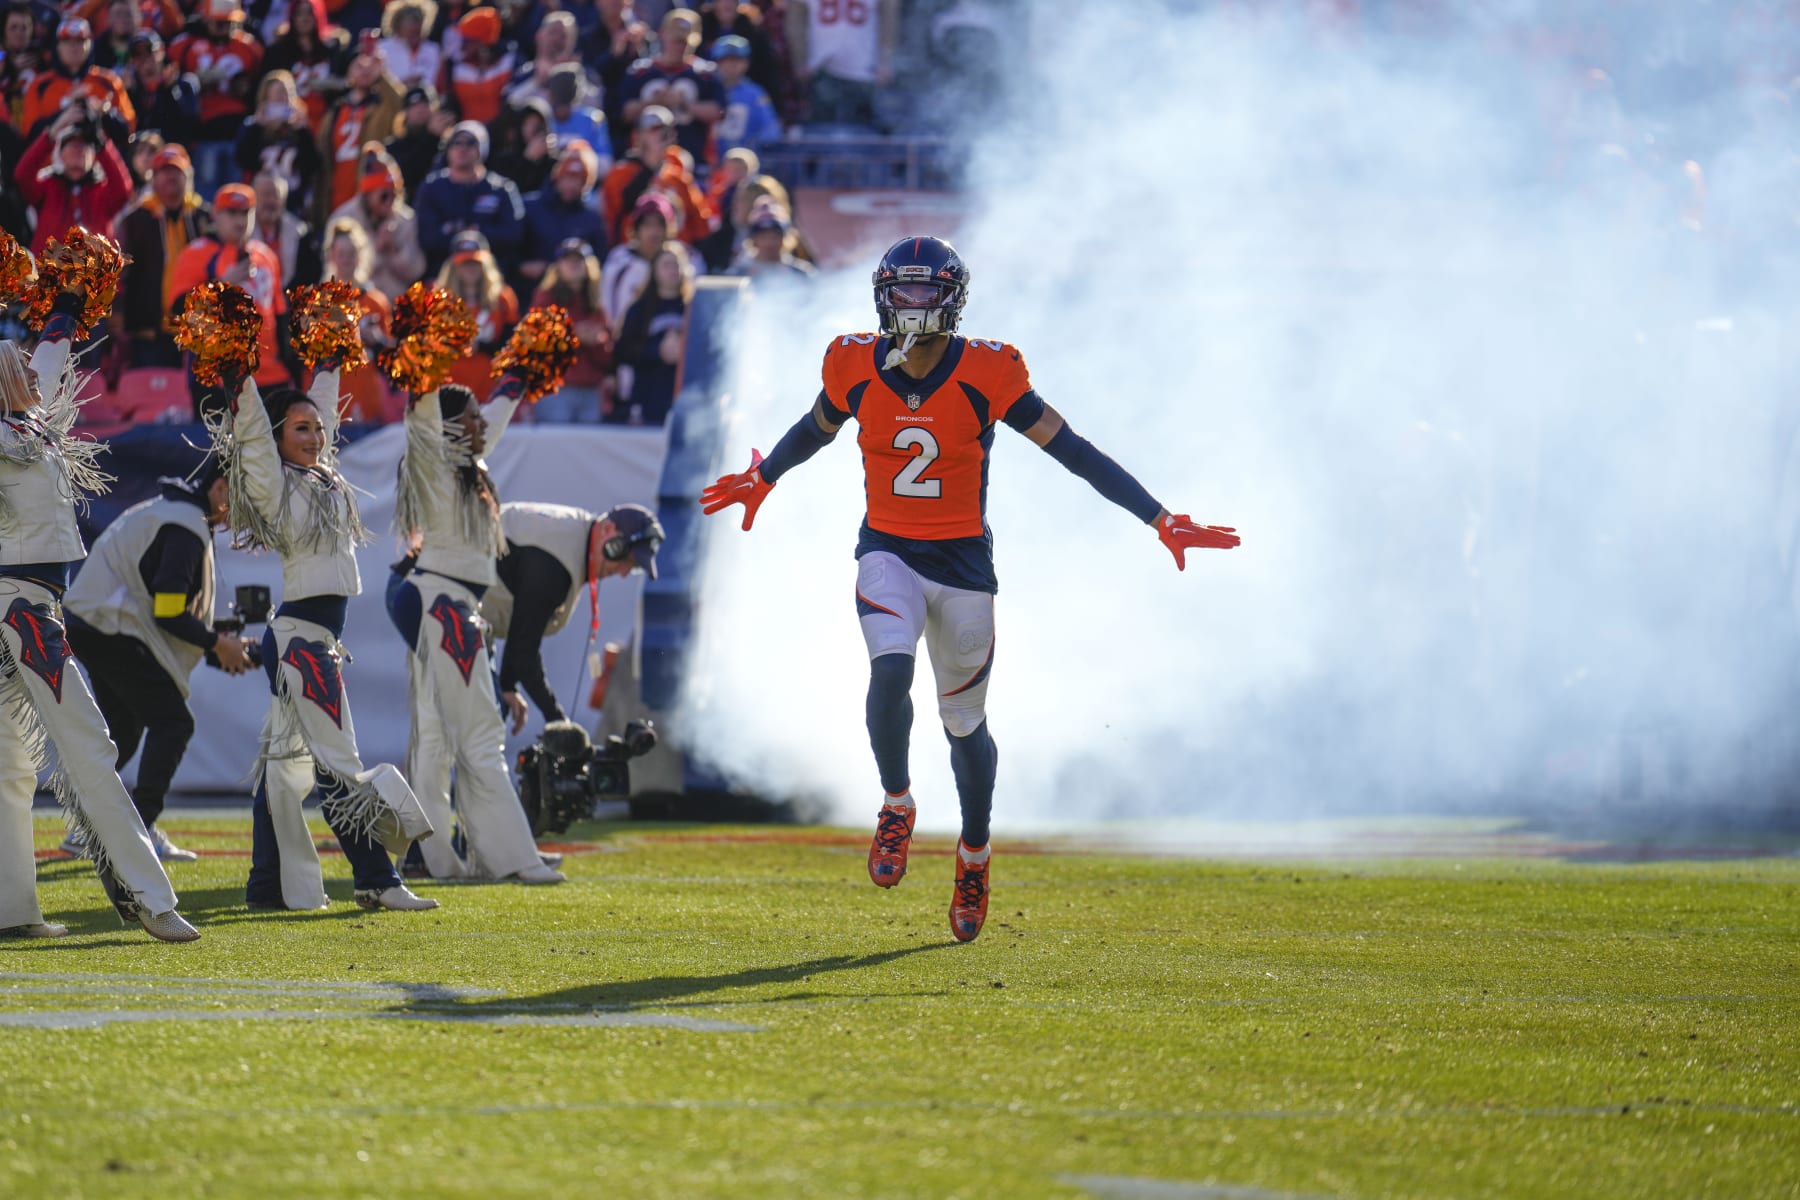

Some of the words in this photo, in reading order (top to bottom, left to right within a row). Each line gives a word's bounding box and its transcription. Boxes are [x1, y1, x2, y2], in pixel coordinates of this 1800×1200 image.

[841, 334, 876, 347] 2
[969, 338, 1003, 352] 2
[892, 426, 942, 498] 2
